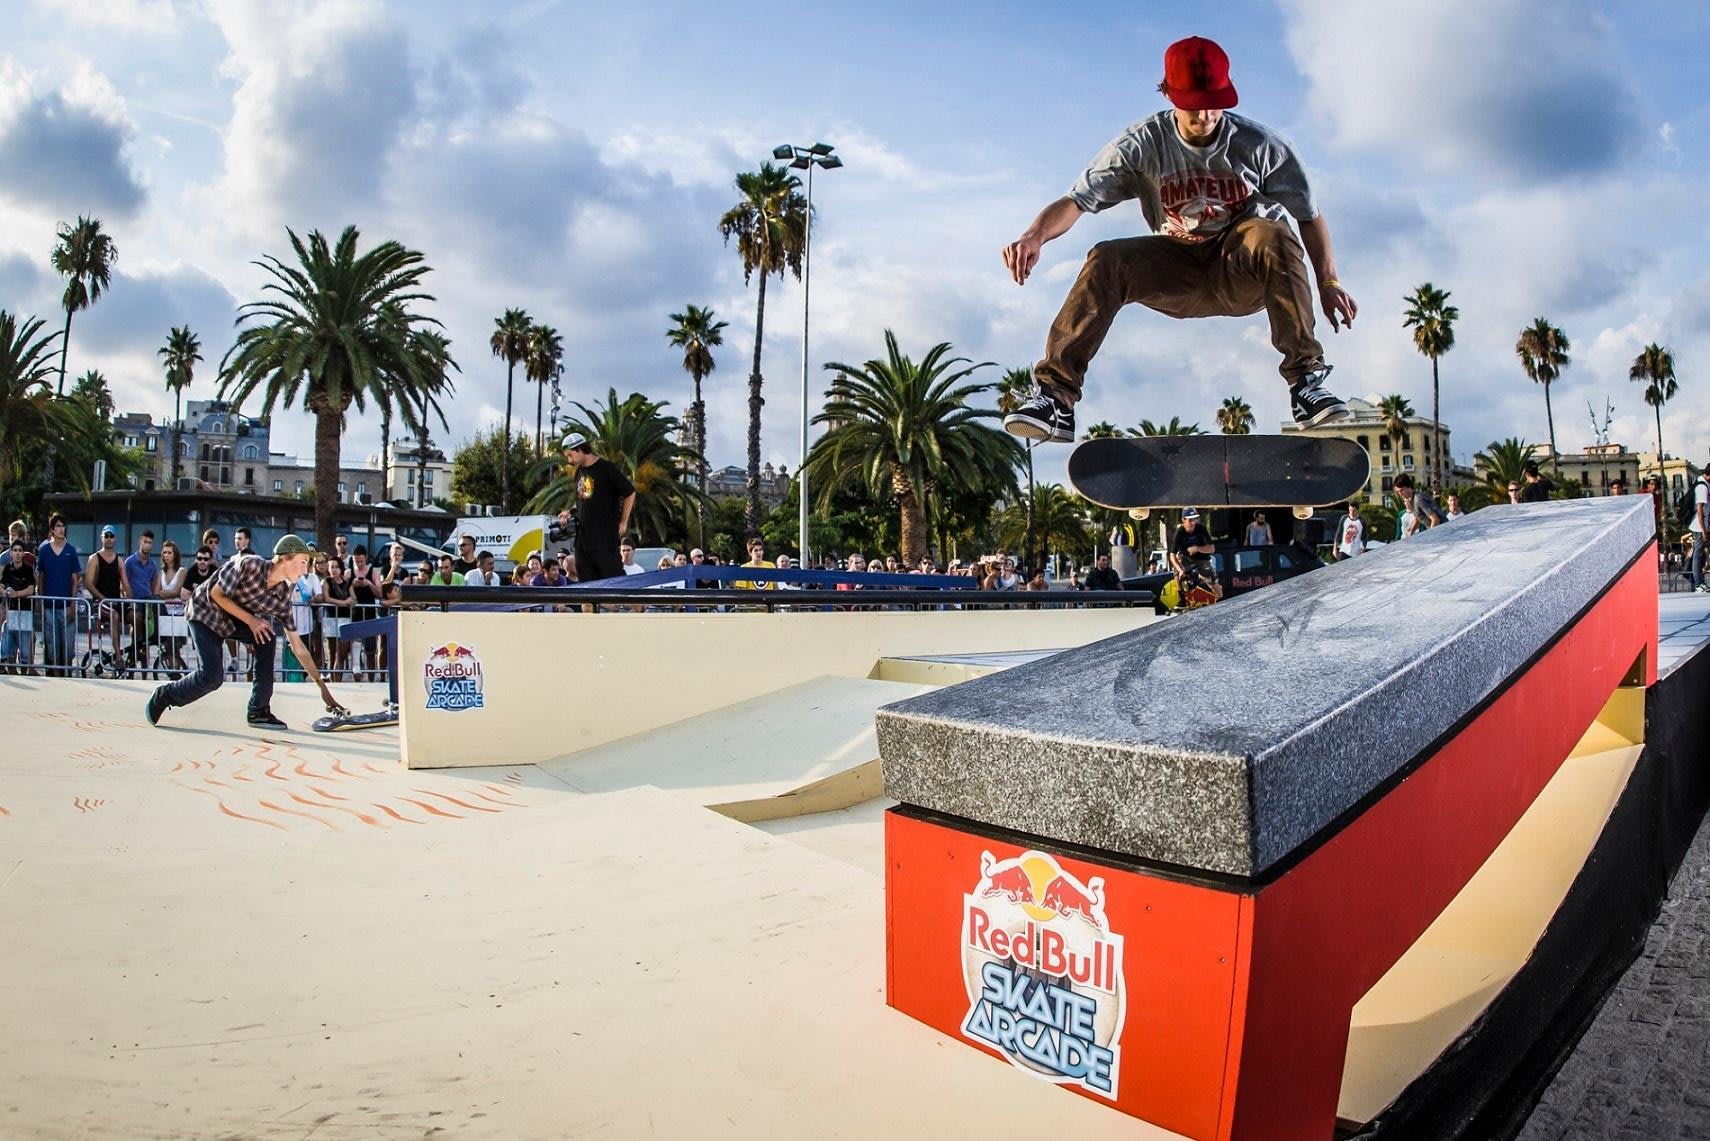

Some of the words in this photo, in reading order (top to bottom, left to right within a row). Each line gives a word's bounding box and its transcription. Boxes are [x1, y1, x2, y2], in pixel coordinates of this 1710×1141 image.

[1232, 576, 1252, 587] Red
[1254, 575, 1273, 586] Bull
[425, 663, 452, 677] Red
[455, 662, 481, 676] Bull
[432, 680, 476, 694] SKATE
[426, 693, 483, 708] ARCADE
[969, 906, 1034, 966] Red
[1042, 928, 1115, 991] Bull
[982, 961, 1097, 1042] SKATE
[966, 998, 1114, 1093] ARCADE
